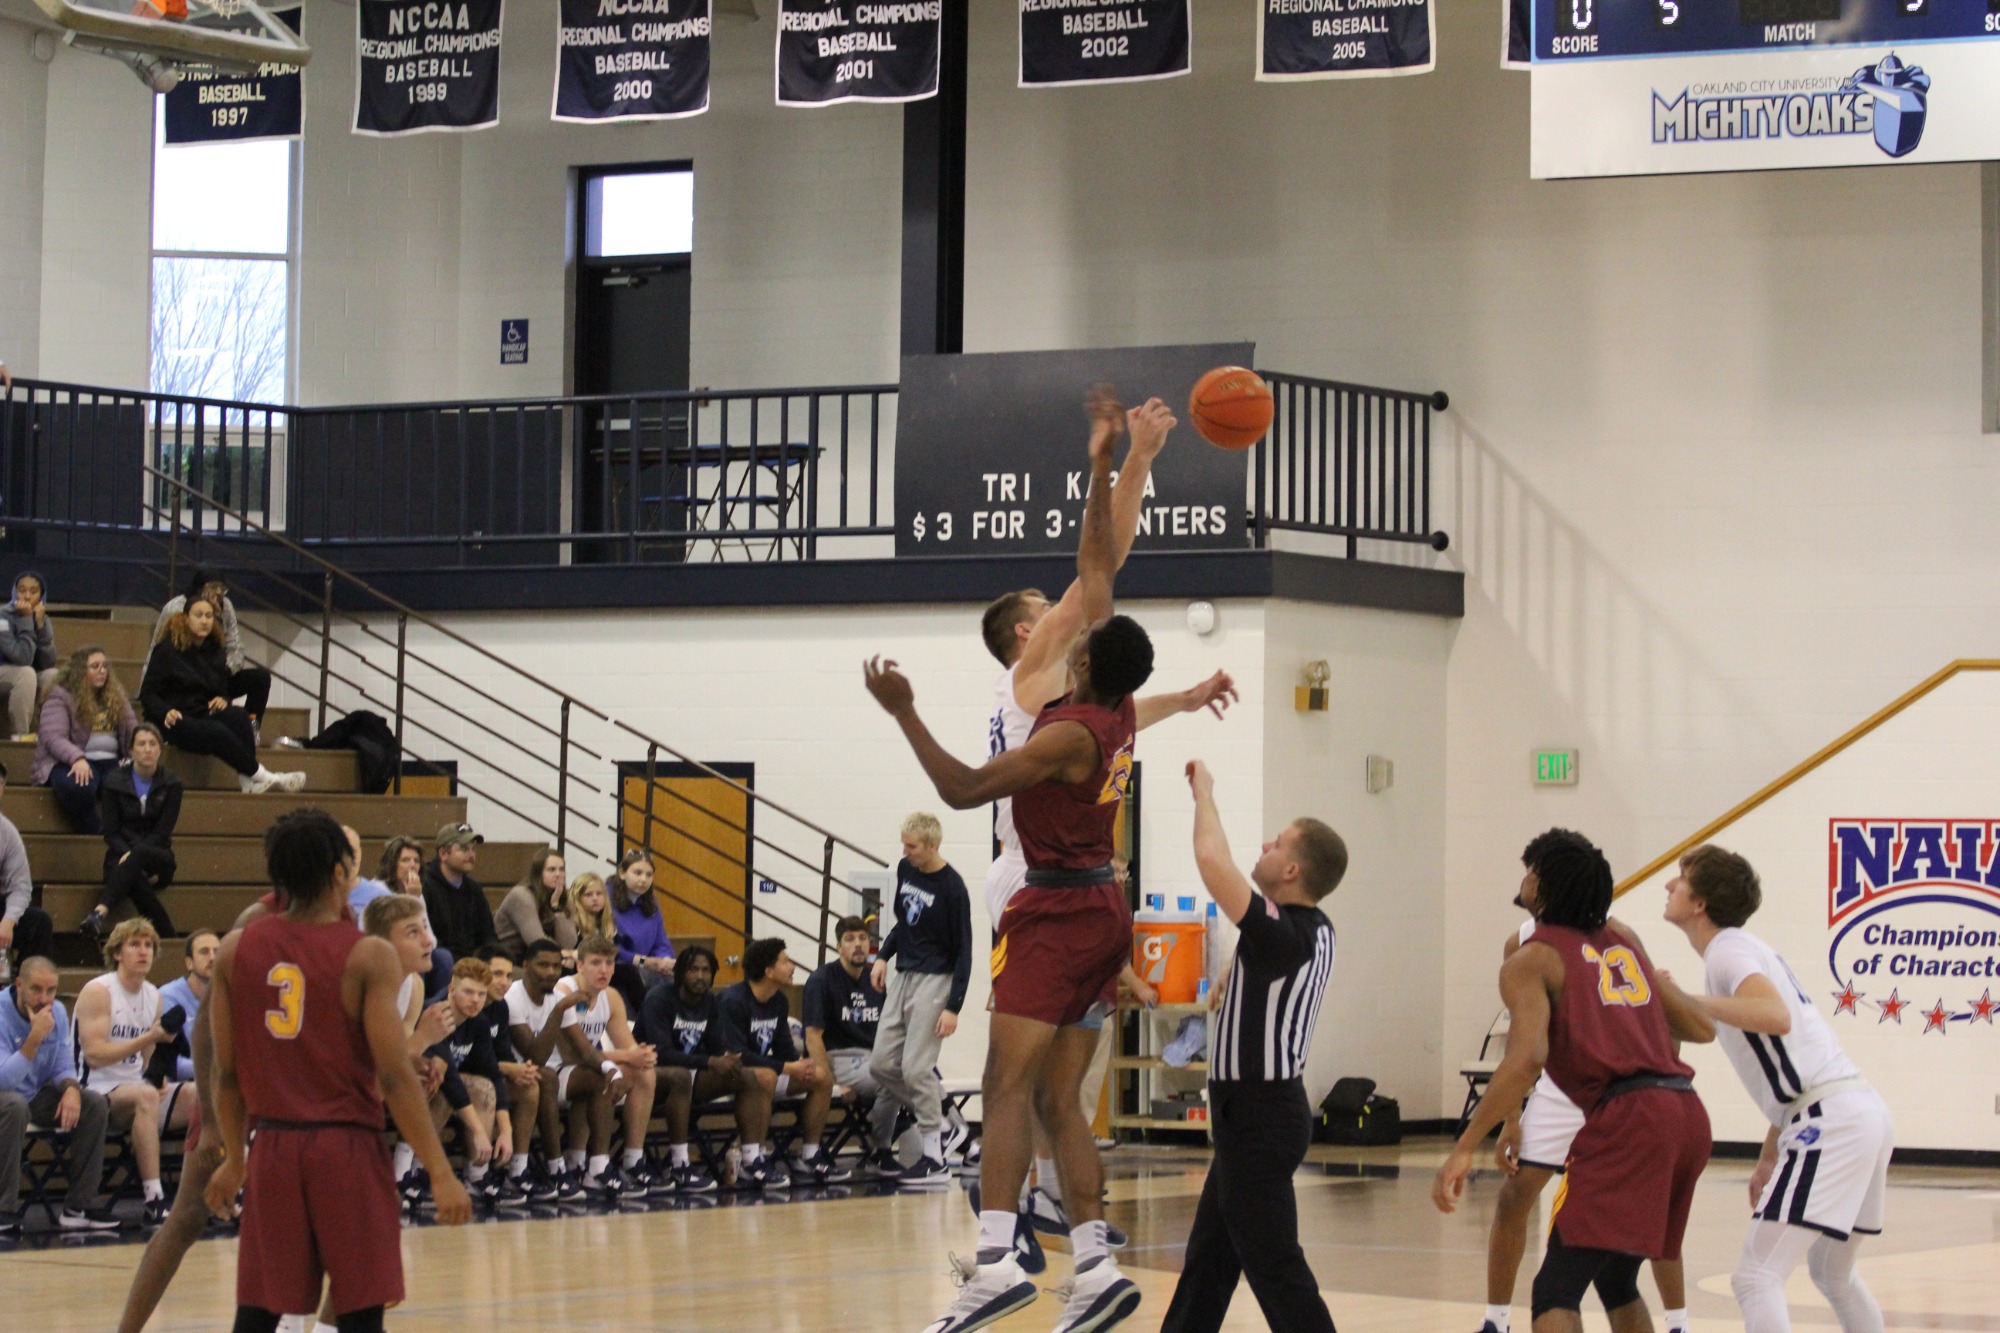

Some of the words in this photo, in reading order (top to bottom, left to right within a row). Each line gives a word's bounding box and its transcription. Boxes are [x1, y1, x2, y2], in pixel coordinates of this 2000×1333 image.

[388, 2, 470, 35] NCCAA
[781, 7, 849, 31] REGIONAL
[856, 3, 939, 25] CHAMPIONS
[1063, 8, 1148, 35] BASEBALL
[1312, 16, 1389, 37] BASEBALL
[360, 37, 423, 59] REGIONAL
[424, 28, 500, 53] CHAMPIONS
[561, 25, 626, 46] REGIONAL
[631, 17, 709, 42] CHAMPIONS
[818, 31, 897, 57] BASEBALL
[1764, 23, 1816, 43] MATCH
[1081, 36, 1129, 58] 2002
[1332, 41, 1366, 60] 2005
[1552, 34, 1599, 55] SCORE
[385, 58, 473, 83] BASEBALL
[595, 51, 670, 75] BASEBALL
[836, 59, 873, 83] 2001
[198, 83, 266, 104] BASEBALL
[408, 82, 447, 104] 1999
[613, 80, 652, 101] 2000
[1692, 82, 1747, 96] OAKLAND
[1750, 80, 1775, 93] CITY
[1778, 77, 1842, 92] UNIVERSITY
[212, 107, 248, 127] 1997
[982, 472, 1031, 502] TRI
[972, 510, 1025, 540] FOR
[1046, 505, 1227, 539] 3-NTERS
[1537, 753, 1569, 780] EXIT
[1835, 826, 2000, 908] NAI
[1143, 936, 1162, 961] G
[1863, 924, 2000, 950] Champion
[1582, 943, 1651, 1007] 23
[1853, 954, 1883, 975] of
[265, 961, 306, 1039] 3
